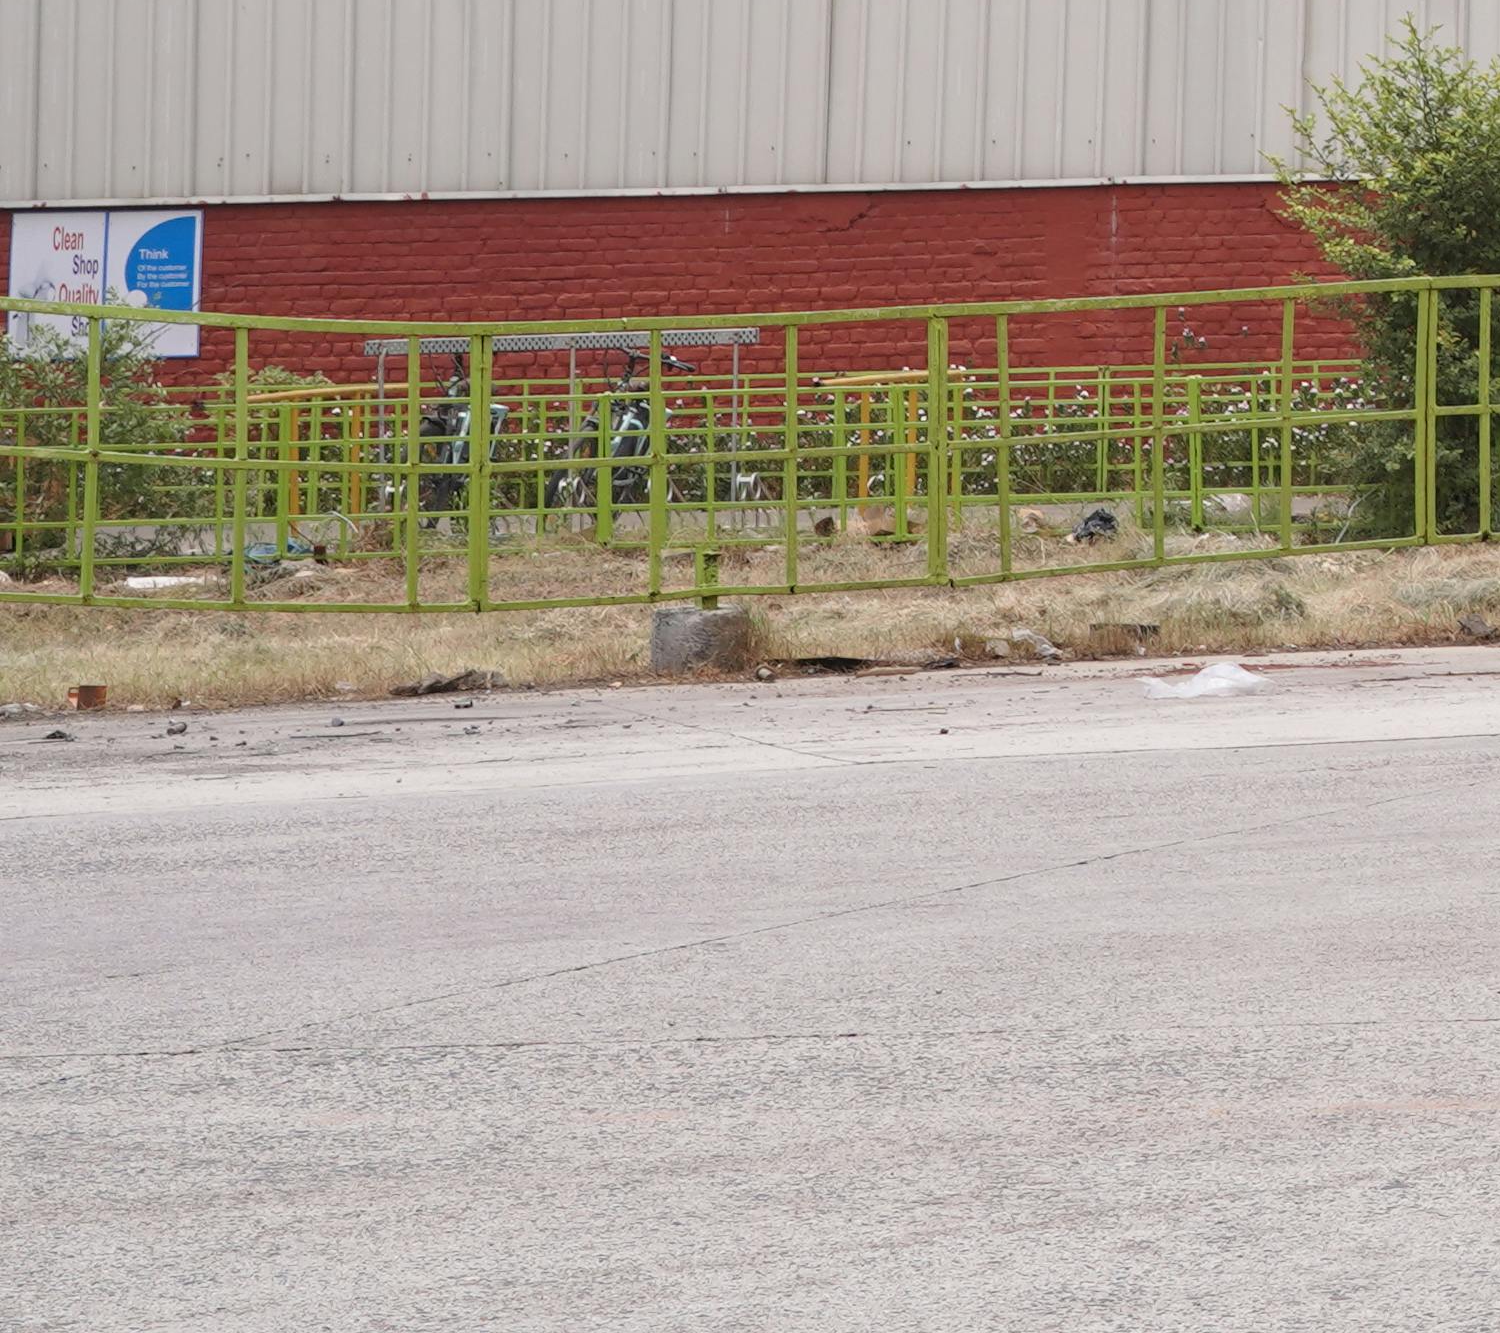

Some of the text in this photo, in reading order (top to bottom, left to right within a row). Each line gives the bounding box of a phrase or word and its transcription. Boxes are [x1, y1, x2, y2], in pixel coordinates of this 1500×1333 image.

[53, 226, 84, 251] Clean
[138, 248, 169, 260] Think
[72, 254, 99, 279] Shop
[147, 272, 157, 280] the
[58, 283, 99, 305] Quality
